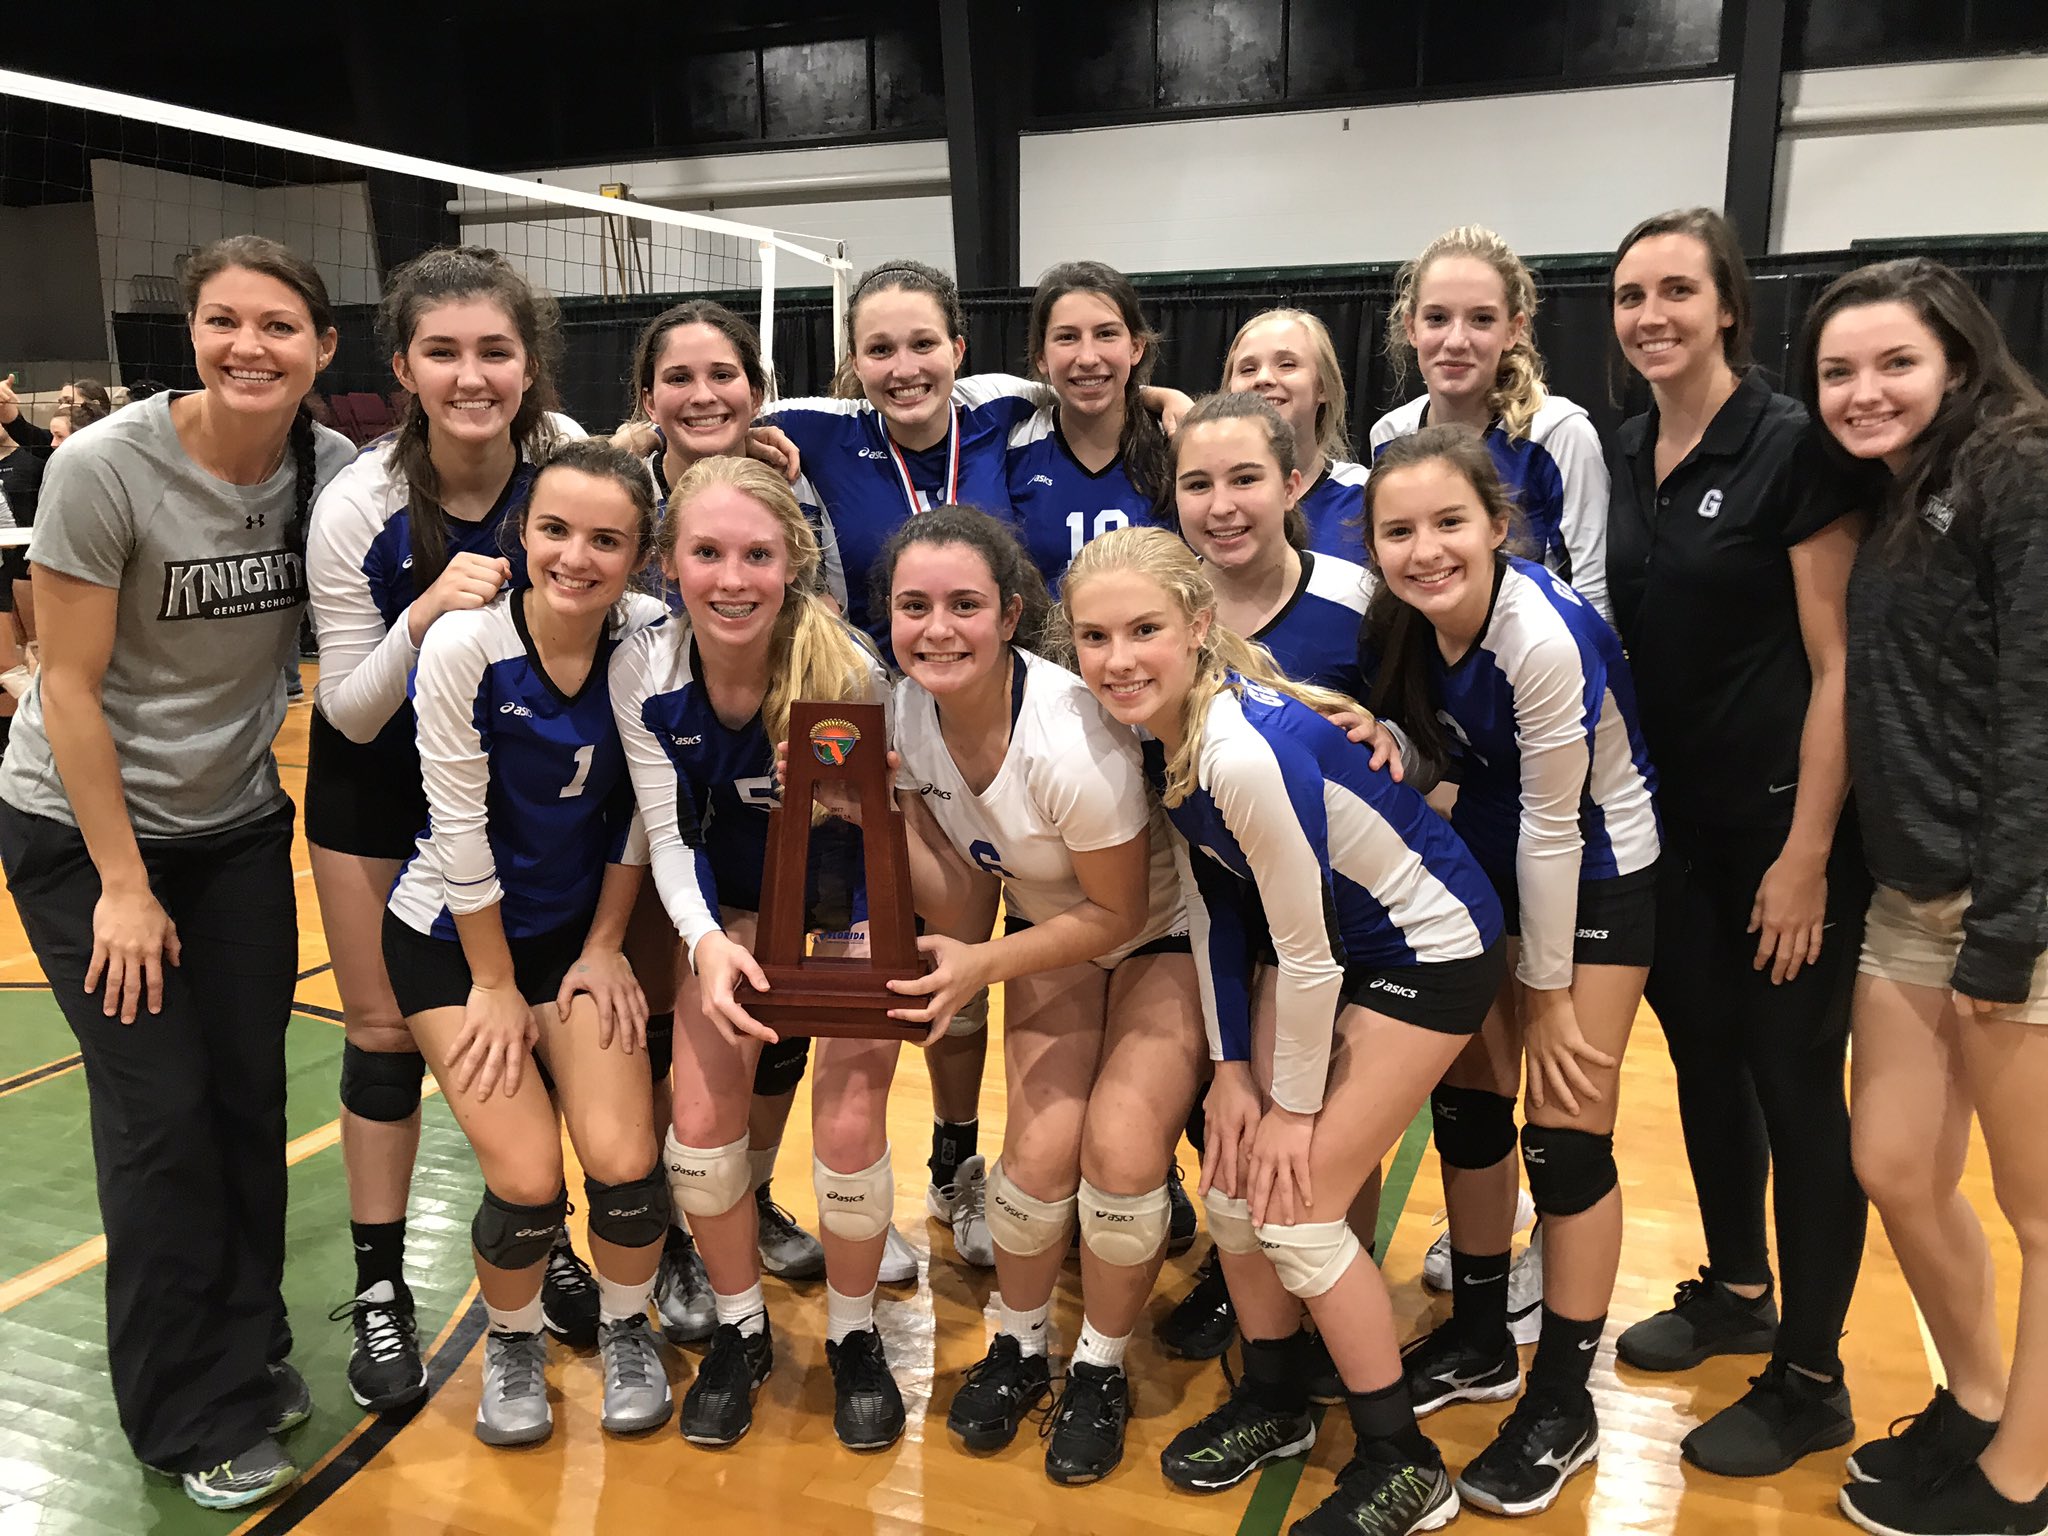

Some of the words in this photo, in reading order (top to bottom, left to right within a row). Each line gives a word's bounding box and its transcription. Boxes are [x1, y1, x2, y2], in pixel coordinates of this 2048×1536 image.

[1698, 489, 1723, 518] G
[213, 601, 256, 616] GENEVA
[260, 595, 296, 609] SCHOOL
[675, 734, 702, 745] asics
[559, 744, 596, 798] 1
[1575, 928, 1609, 940] asics
[1383, 981, 1419, 999] asics
[679, 1167, 707, 1178] asics
[837, 1191, 866, 1203] asics
[1004, 1203, 1030, 1222] asics
